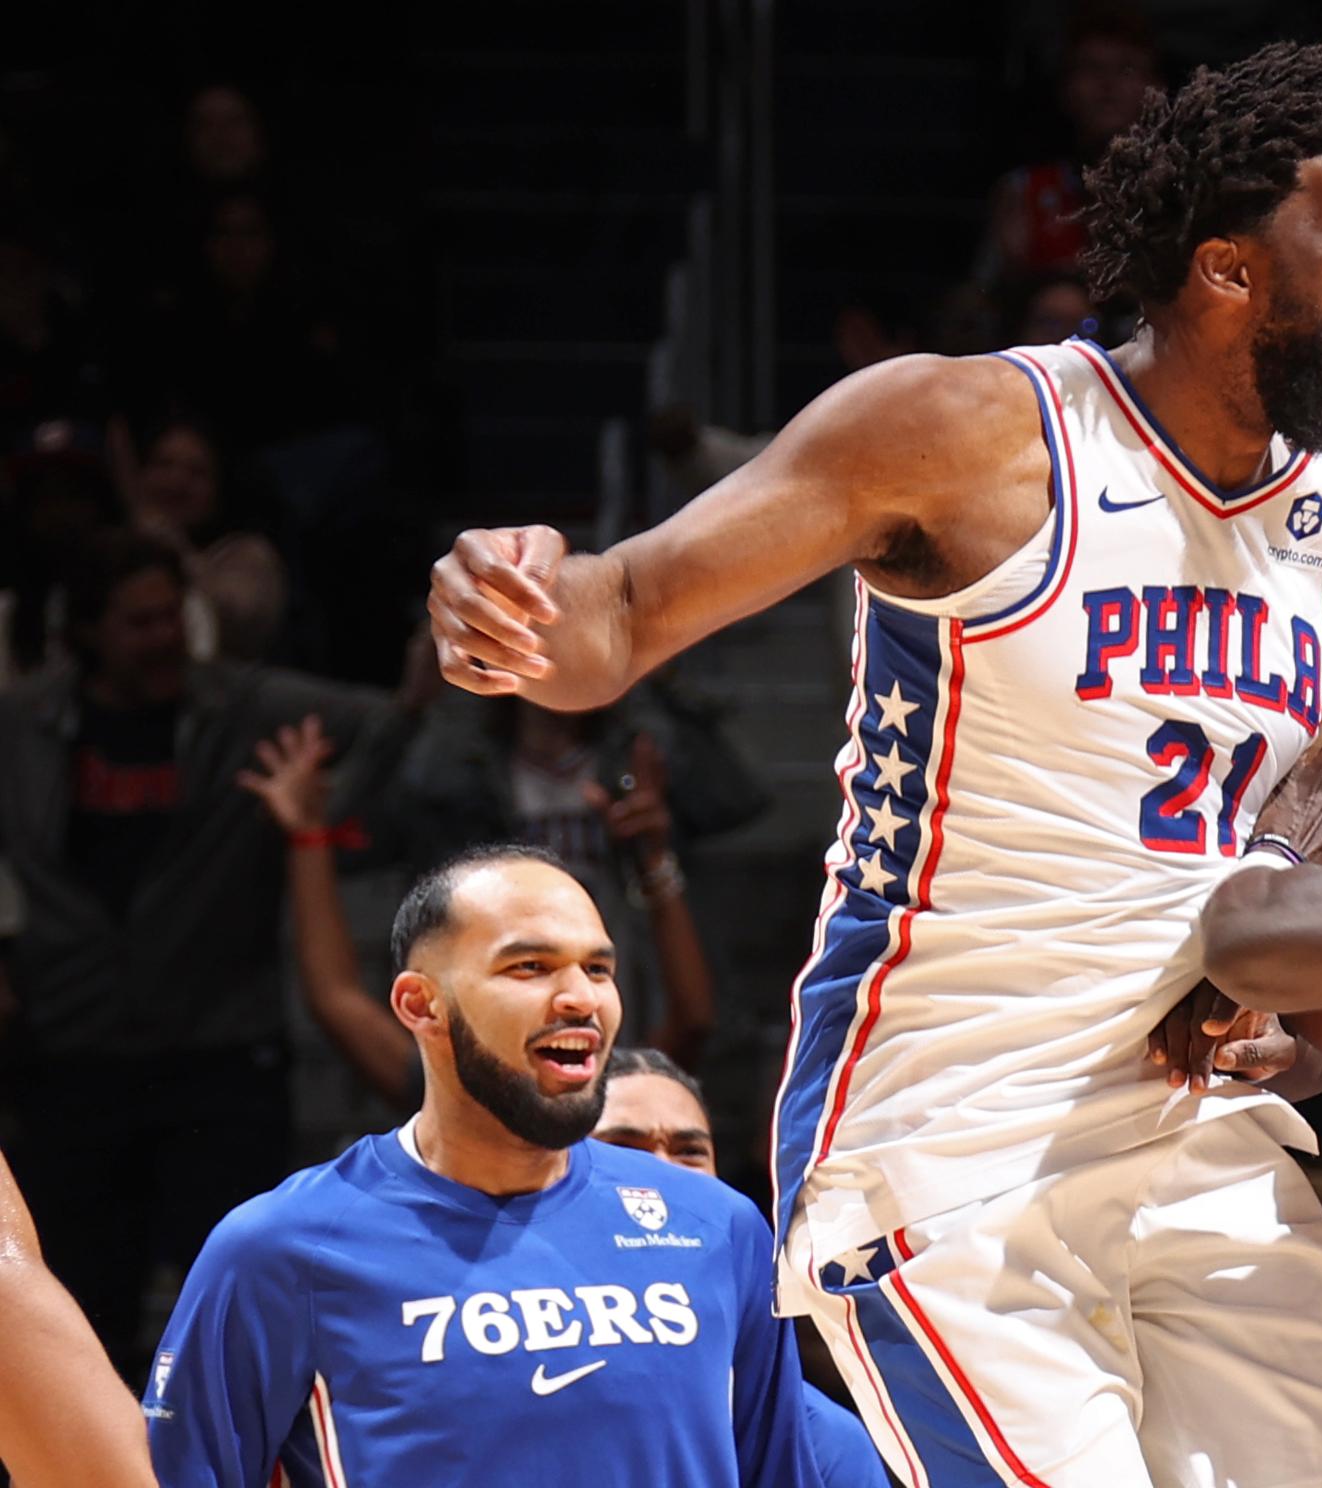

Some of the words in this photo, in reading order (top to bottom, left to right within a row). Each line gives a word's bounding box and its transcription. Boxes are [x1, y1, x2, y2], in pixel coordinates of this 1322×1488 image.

[1075, 585, 1322, 737] PHILA
[1139, 719, 1268, 857] 21
[614, 1234, 647, 1248] Penn
[645, 1232, 702, 1248] Medicine
[402, 1282, 698, 1362] 76ERS
